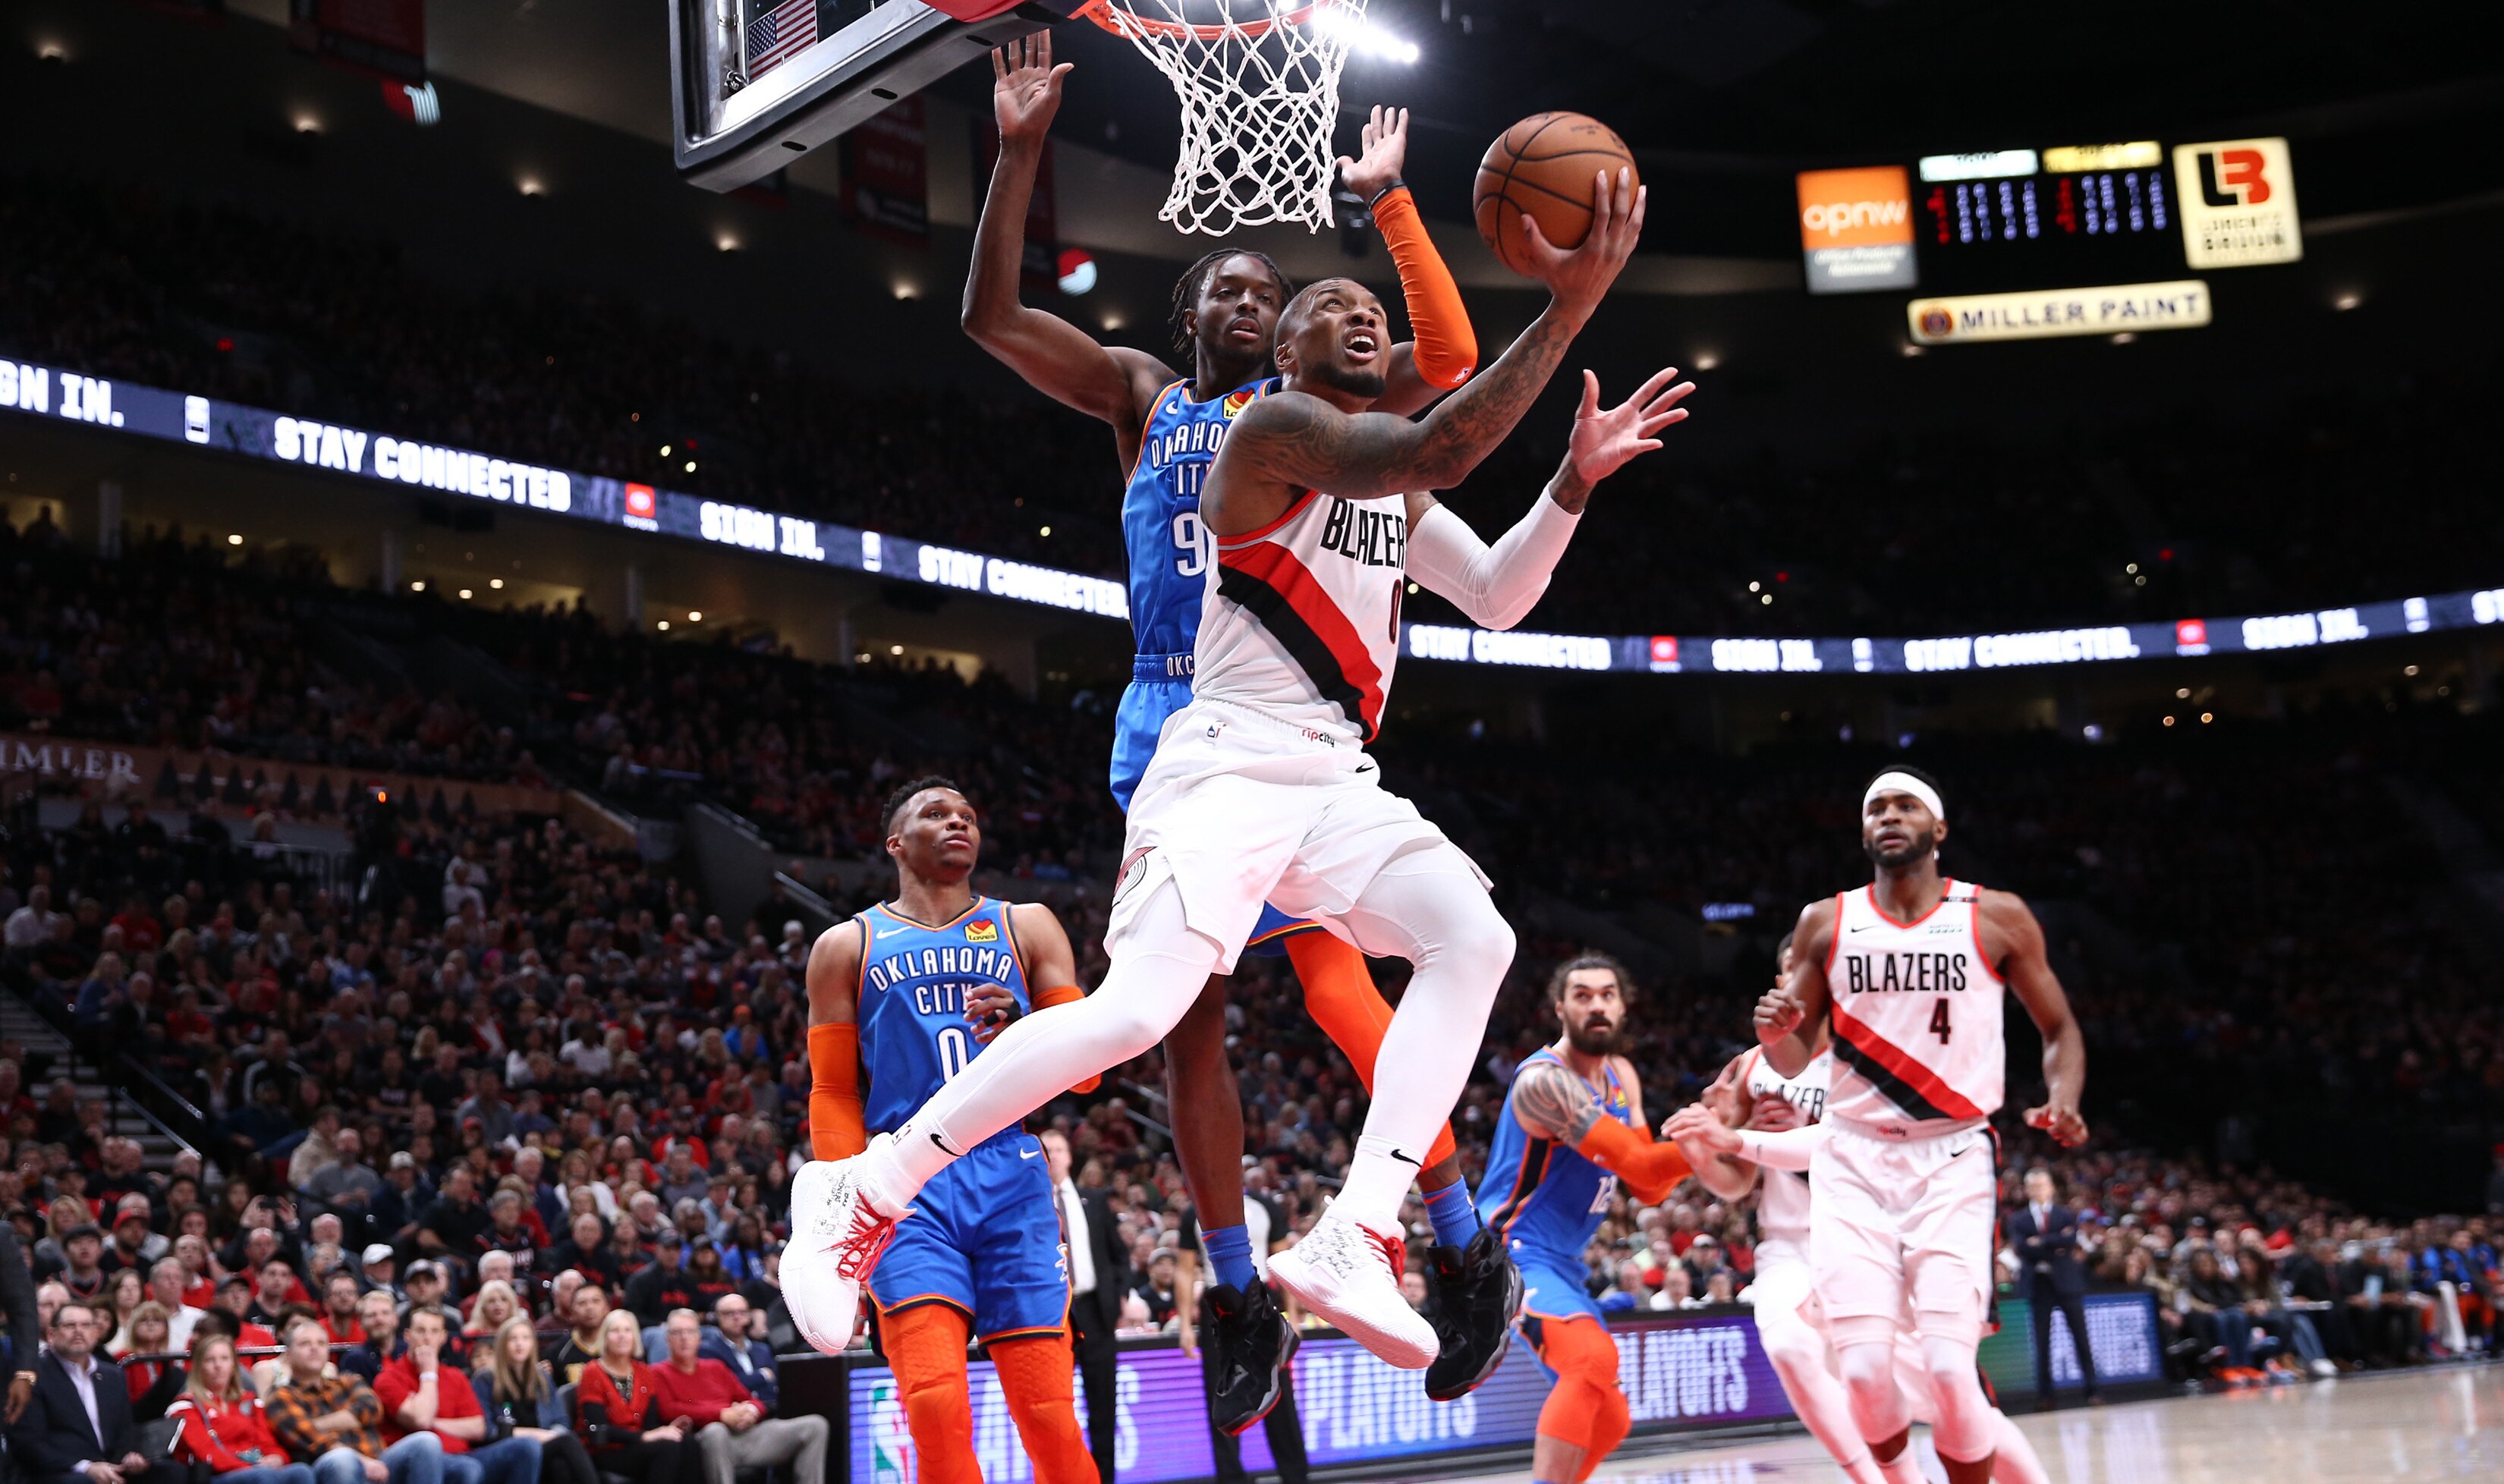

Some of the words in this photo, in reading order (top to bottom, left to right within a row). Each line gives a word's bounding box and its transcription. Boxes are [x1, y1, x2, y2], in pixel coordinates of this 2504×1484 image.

[1802, 199, 1908, 238] opnw
[1961, 300, 2085, 330] MILLER
[2100, 291, 2200, 320] PAINT
[59, 373, 124, 427] IN.
[274, 416, 368, 473] STAY
[374, 436, 571, 513] CONNECTED
[700, 501, 775, 552] SIGN
[779, 517, 826, 561] IN.
[1173, 511, 1206, 577] 9
[917, 544, 984, 591] STAY
[1408, 624, 1471, 662] STAY
[1471, 629, 1612, 671] CONNECTED
[1711, 638, 1779, 671] SIGN
[1903, 637, 1972, 672] STAY
[2241, 613, 2317, 650] SIGN
[1166, 655, 1194, 677] OKC
[870, 947, 1014, 992] OKLAHOMA
[1846, 954, 1967, 994] BLAZERS
[915, 983, 974, 1015] CITY
[1930, 998, 1951, 1045] 4
[937, 1027, 970, 1083] 0
[1304, 1350, 1478, 1452] PLAYOS
